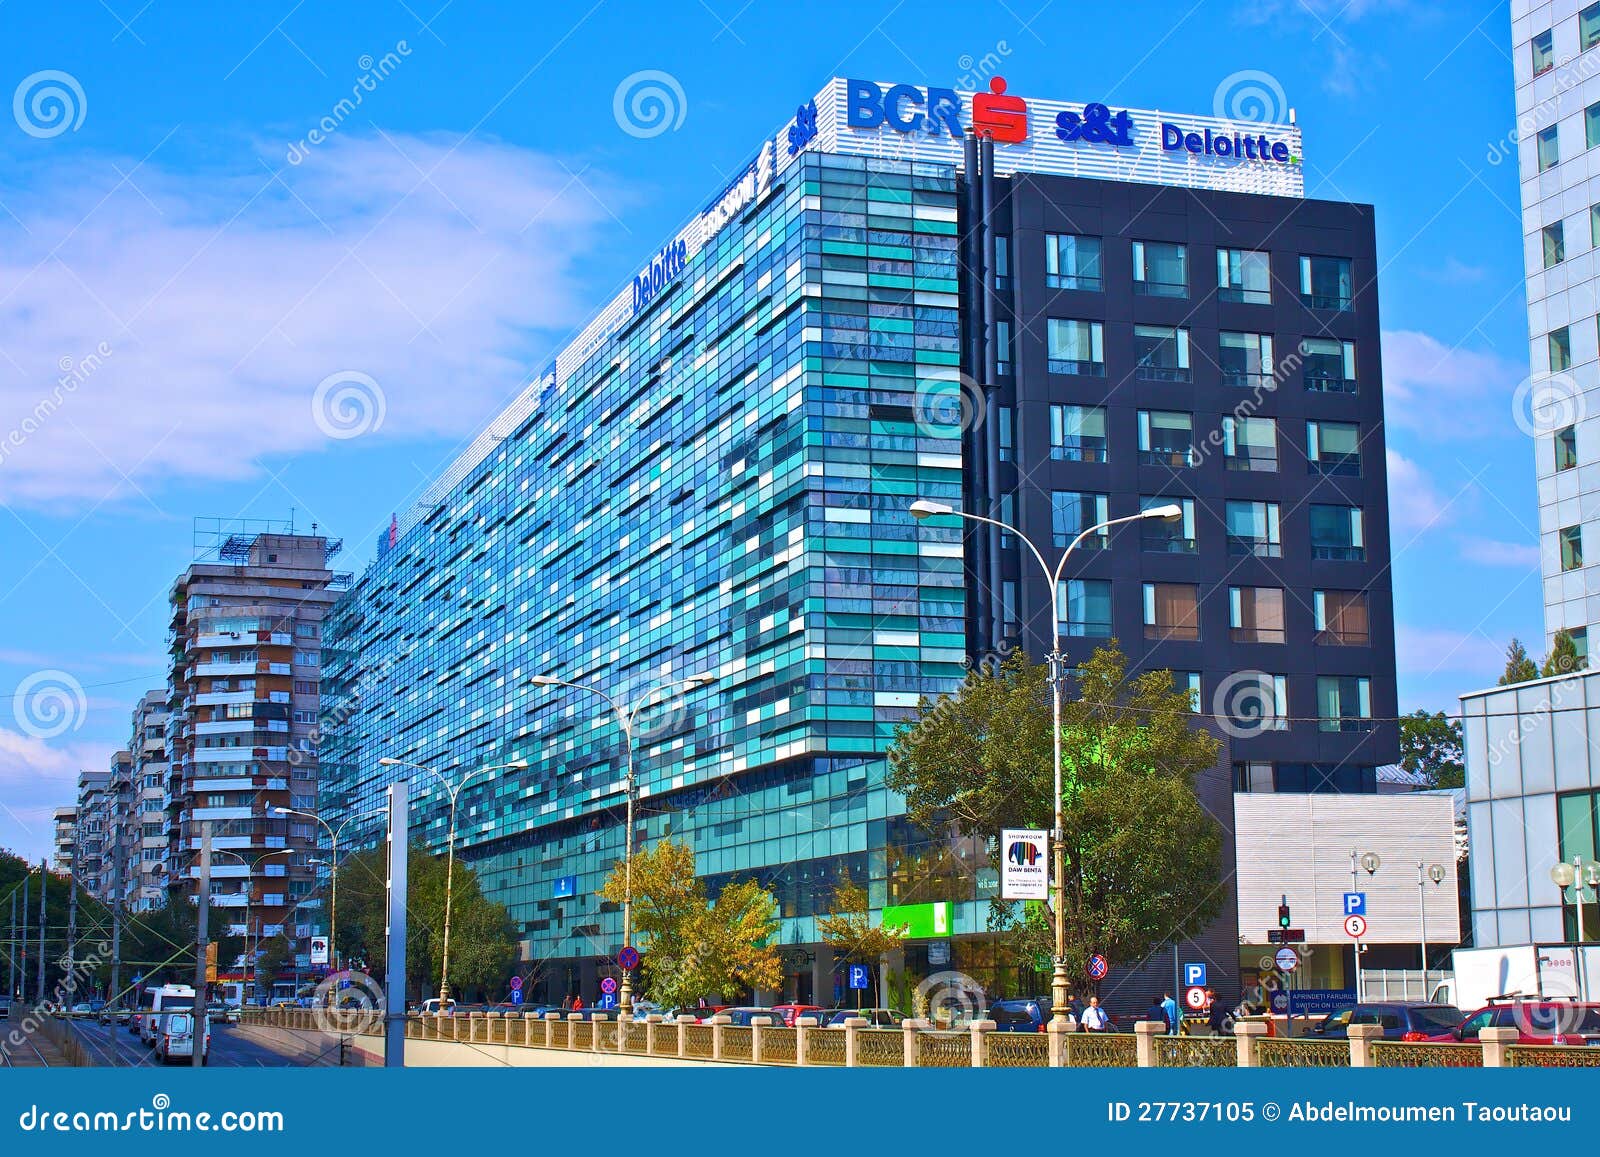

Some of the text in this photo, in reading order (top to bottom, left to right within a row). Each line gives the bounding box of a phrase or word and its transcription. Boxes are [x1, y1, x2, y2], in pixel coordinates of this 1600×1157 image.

[846, 78, 965, 137] BCR
[1055, 102, 1134, 146] s&t
[1347, 895, 1361, 913] P
[1352, 920, 1359, 932] 5
[1188, 966, 1202, 984] P
[605, 995, 613, 1009] P
[1193, 992, 1200, 1003] 5
